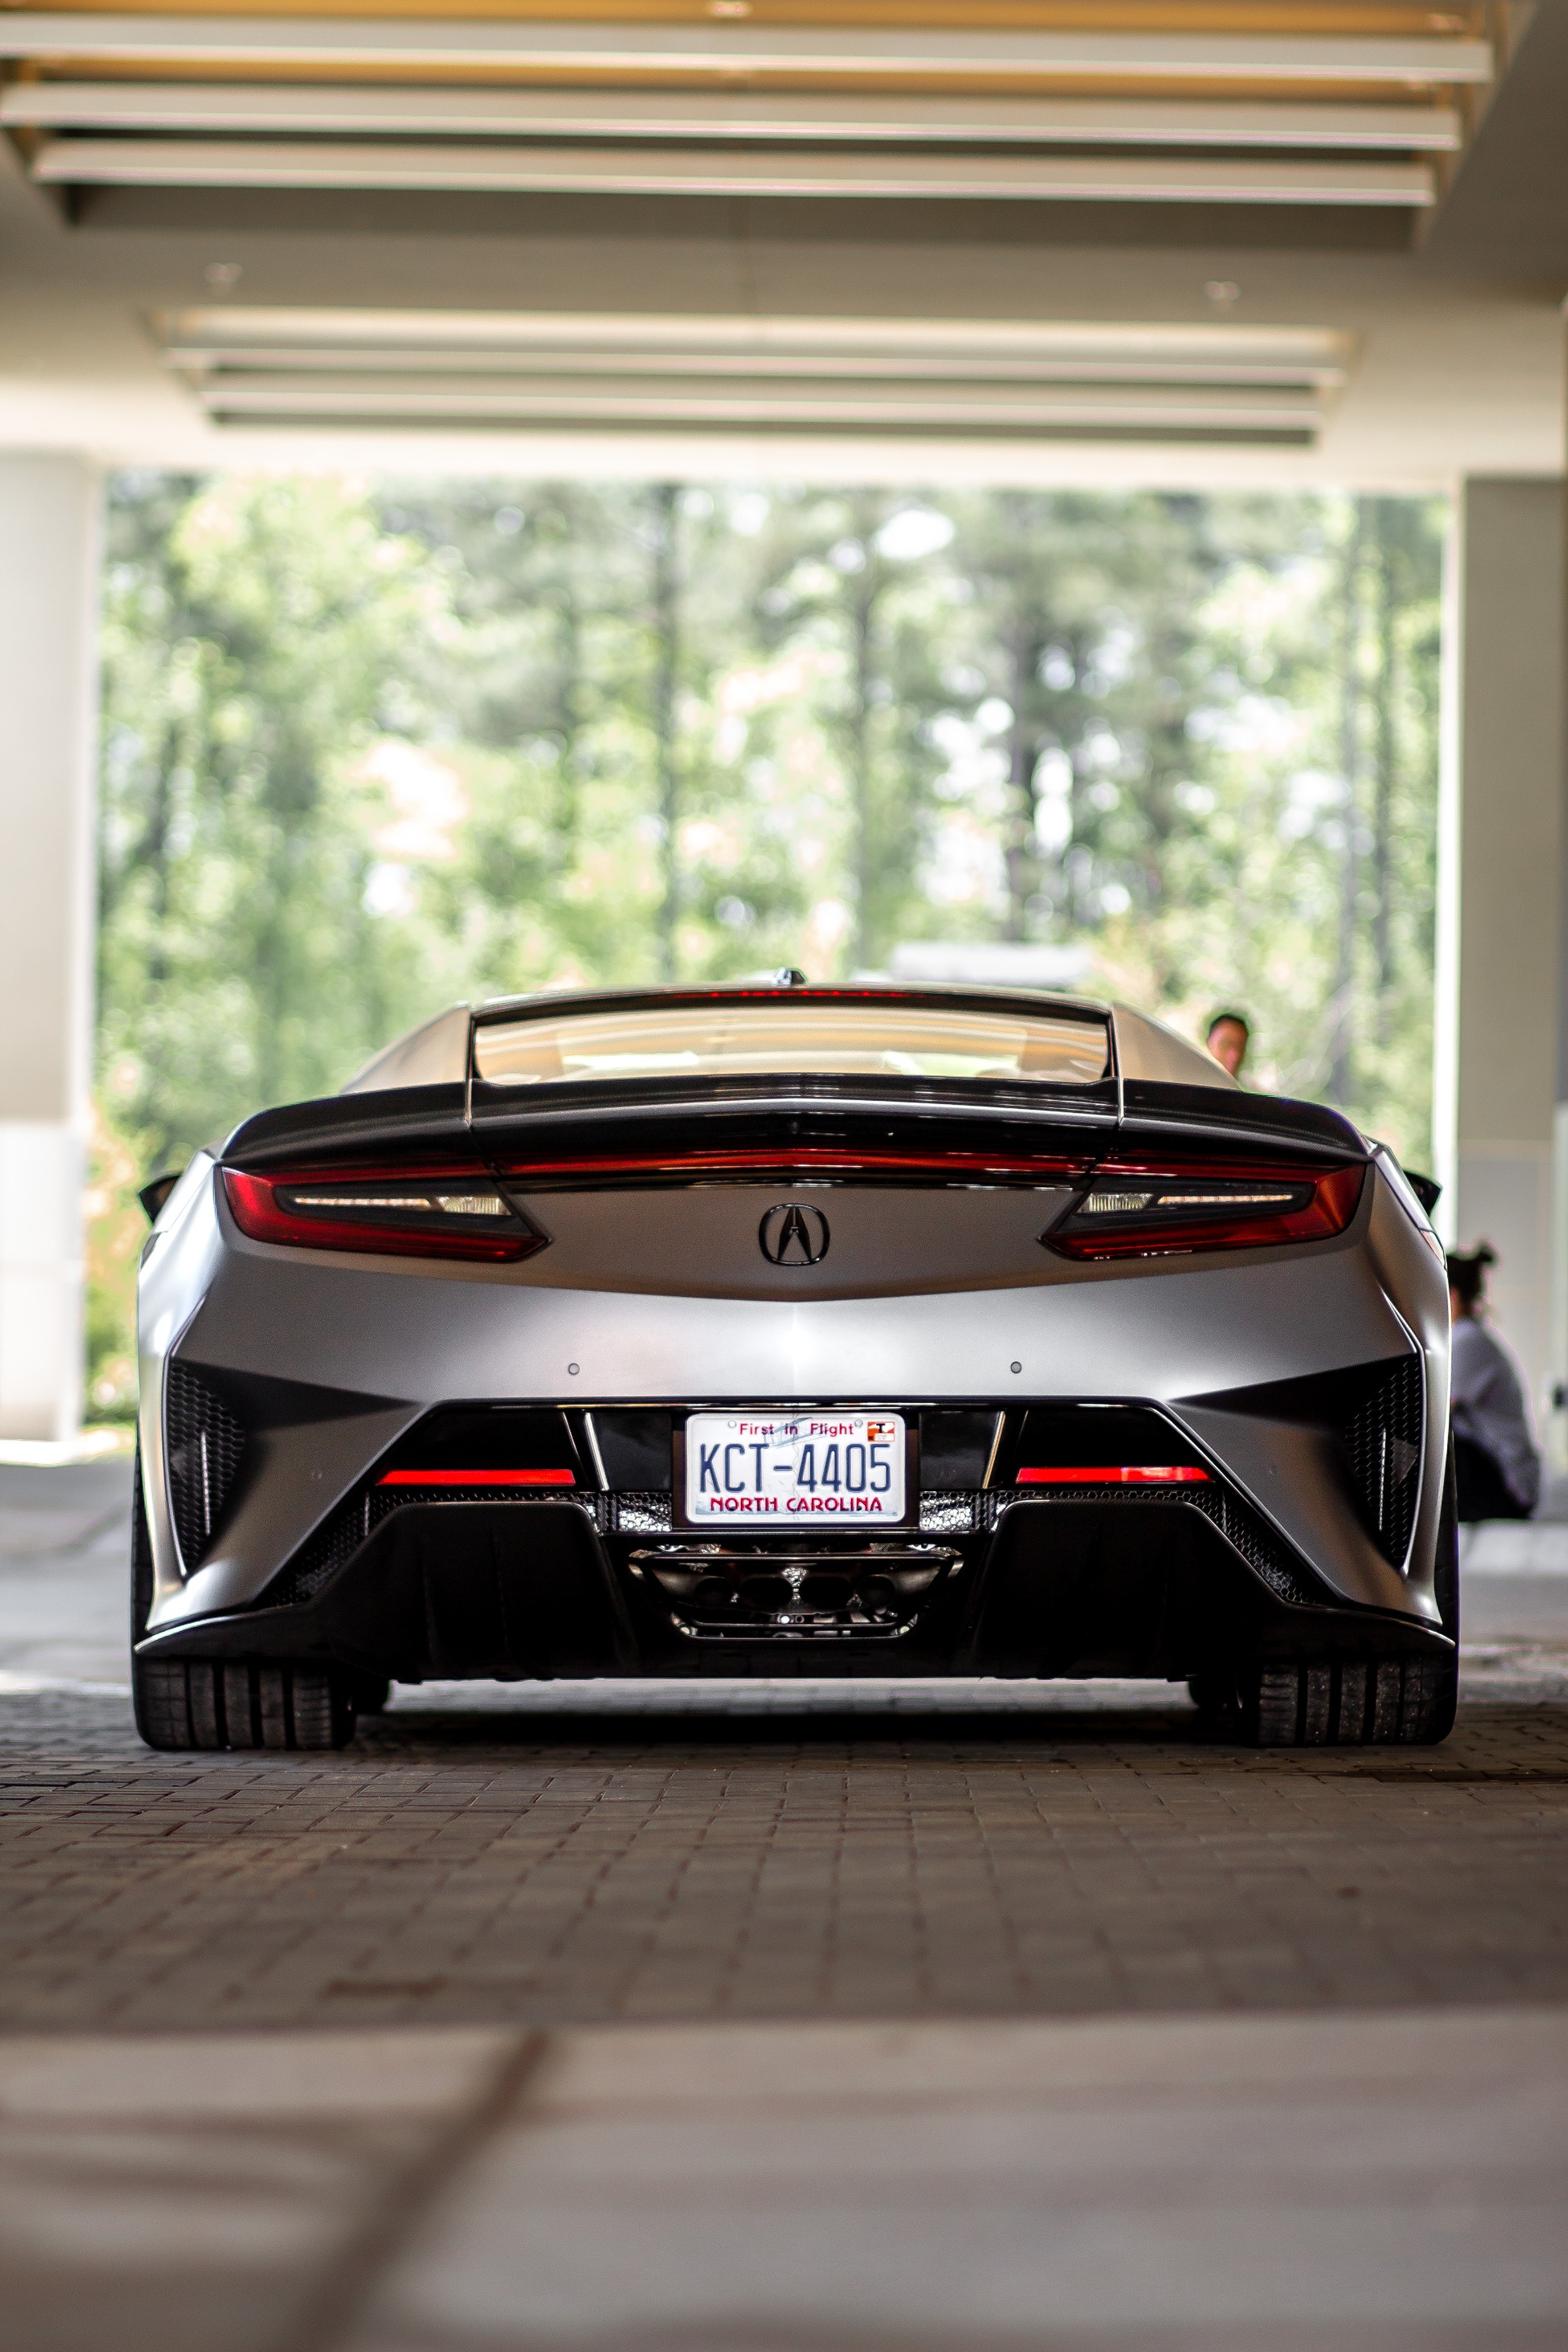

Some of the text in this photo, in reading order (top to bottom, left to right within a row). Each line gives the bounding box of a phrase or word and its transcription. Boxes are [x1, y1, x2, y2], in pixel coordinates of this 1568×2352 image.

[739, 1423, 774, 1435] First
[810, 1423, 854, 1437] Flight
[700, 1443, 891, 1493] KCT-4405
[710, 1497, 883, 1512] NORTH CAROLINA
